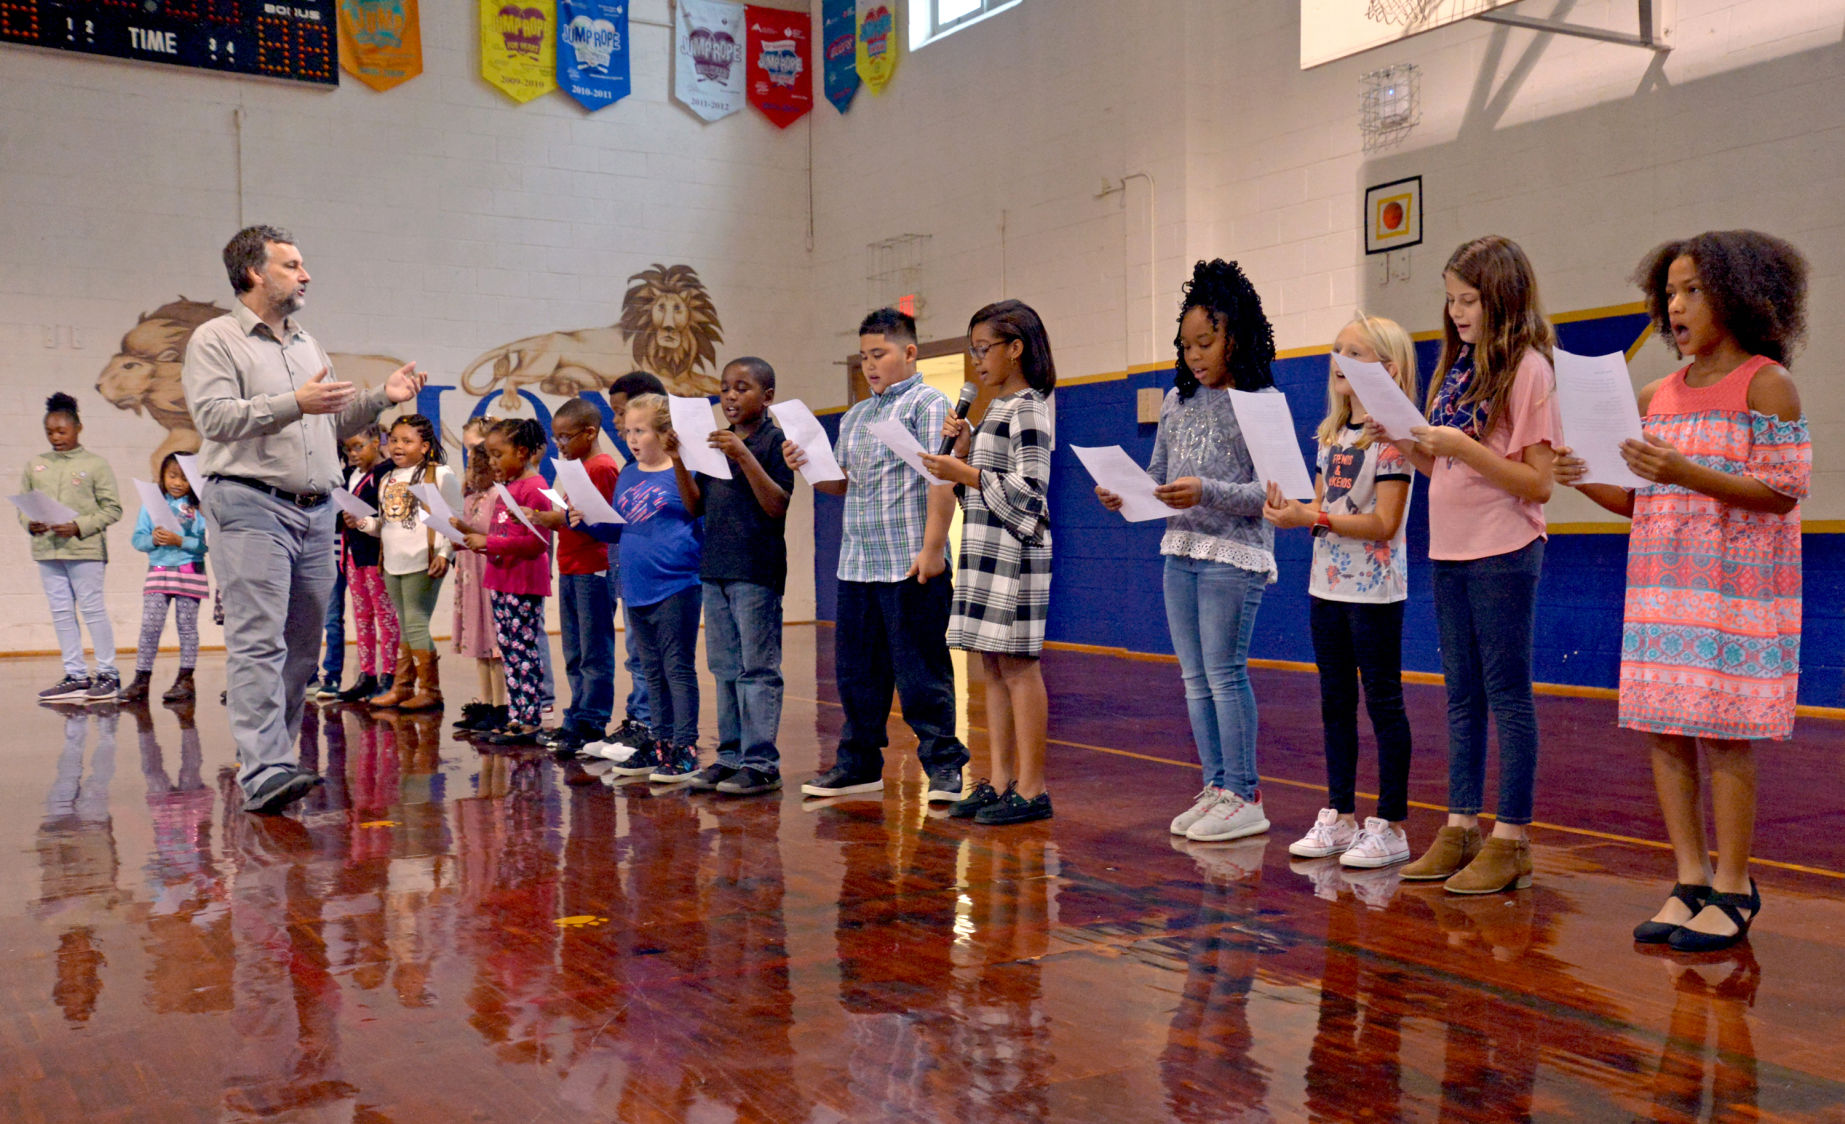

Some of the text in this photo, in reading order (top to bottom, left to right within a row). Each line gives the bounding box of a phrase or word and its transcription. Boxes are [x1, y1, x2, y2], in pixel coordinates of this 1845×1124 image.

[264, 3, 321, 20] BONUS
[66, 17, 73, 31] 1
[85, 20, 94, 34] 2
[493, 13, 549, 38] JUMP ROPE
[128, 26, 178, 54] TIME
[208, 37, 217, 52] 3
[562, 24, 621, 51] JUMP ROPE
[226, 41, 234, 54] 4
[680, 36, 713, 58] JUMP
[713, 40, 742, 63] ROPE
[572, 84, 613, 99] 2010-2011
[691, 97, 730, 111] 2011-2012
